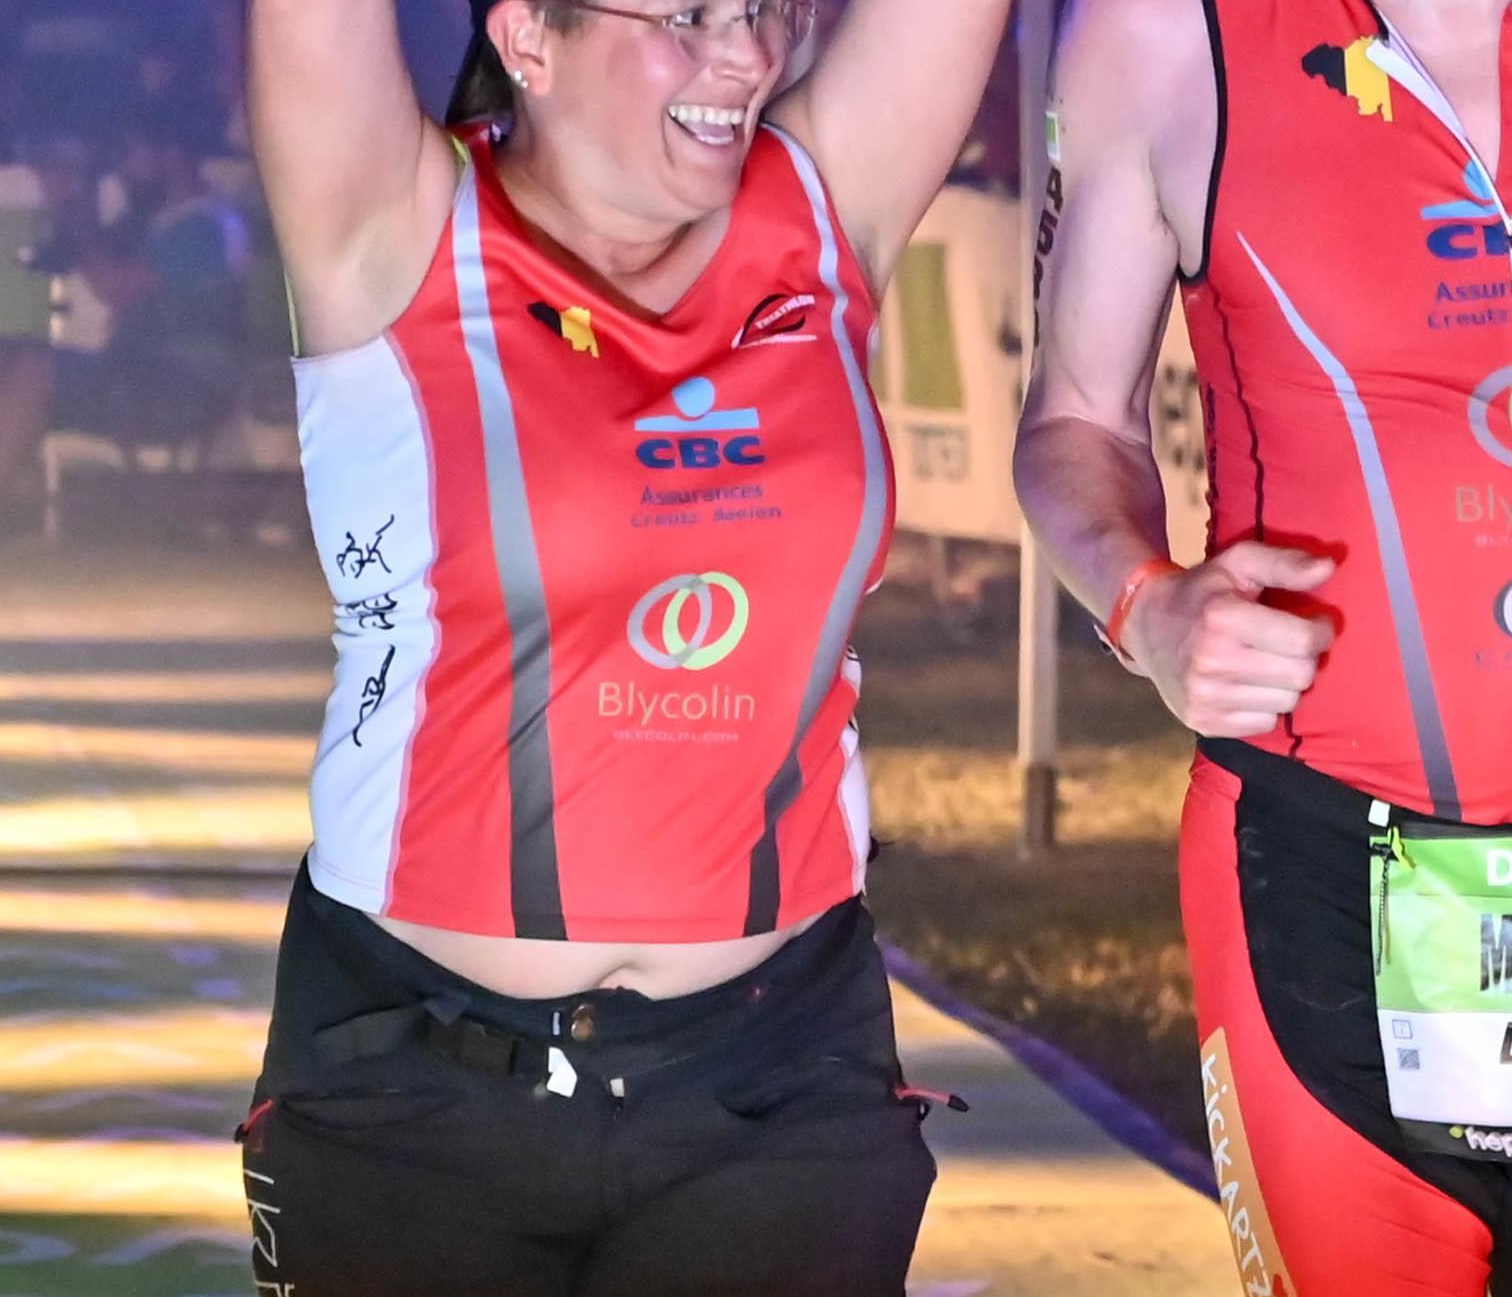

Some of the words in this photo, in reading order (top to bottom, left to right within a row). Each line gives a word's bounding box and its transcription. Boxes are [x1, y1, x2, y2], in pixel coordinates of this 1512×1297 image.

[635, 435, 767, 471] CBC
[640, 483, 764, 506] Assurances
[597, 680, 756, 727] Blycolin
